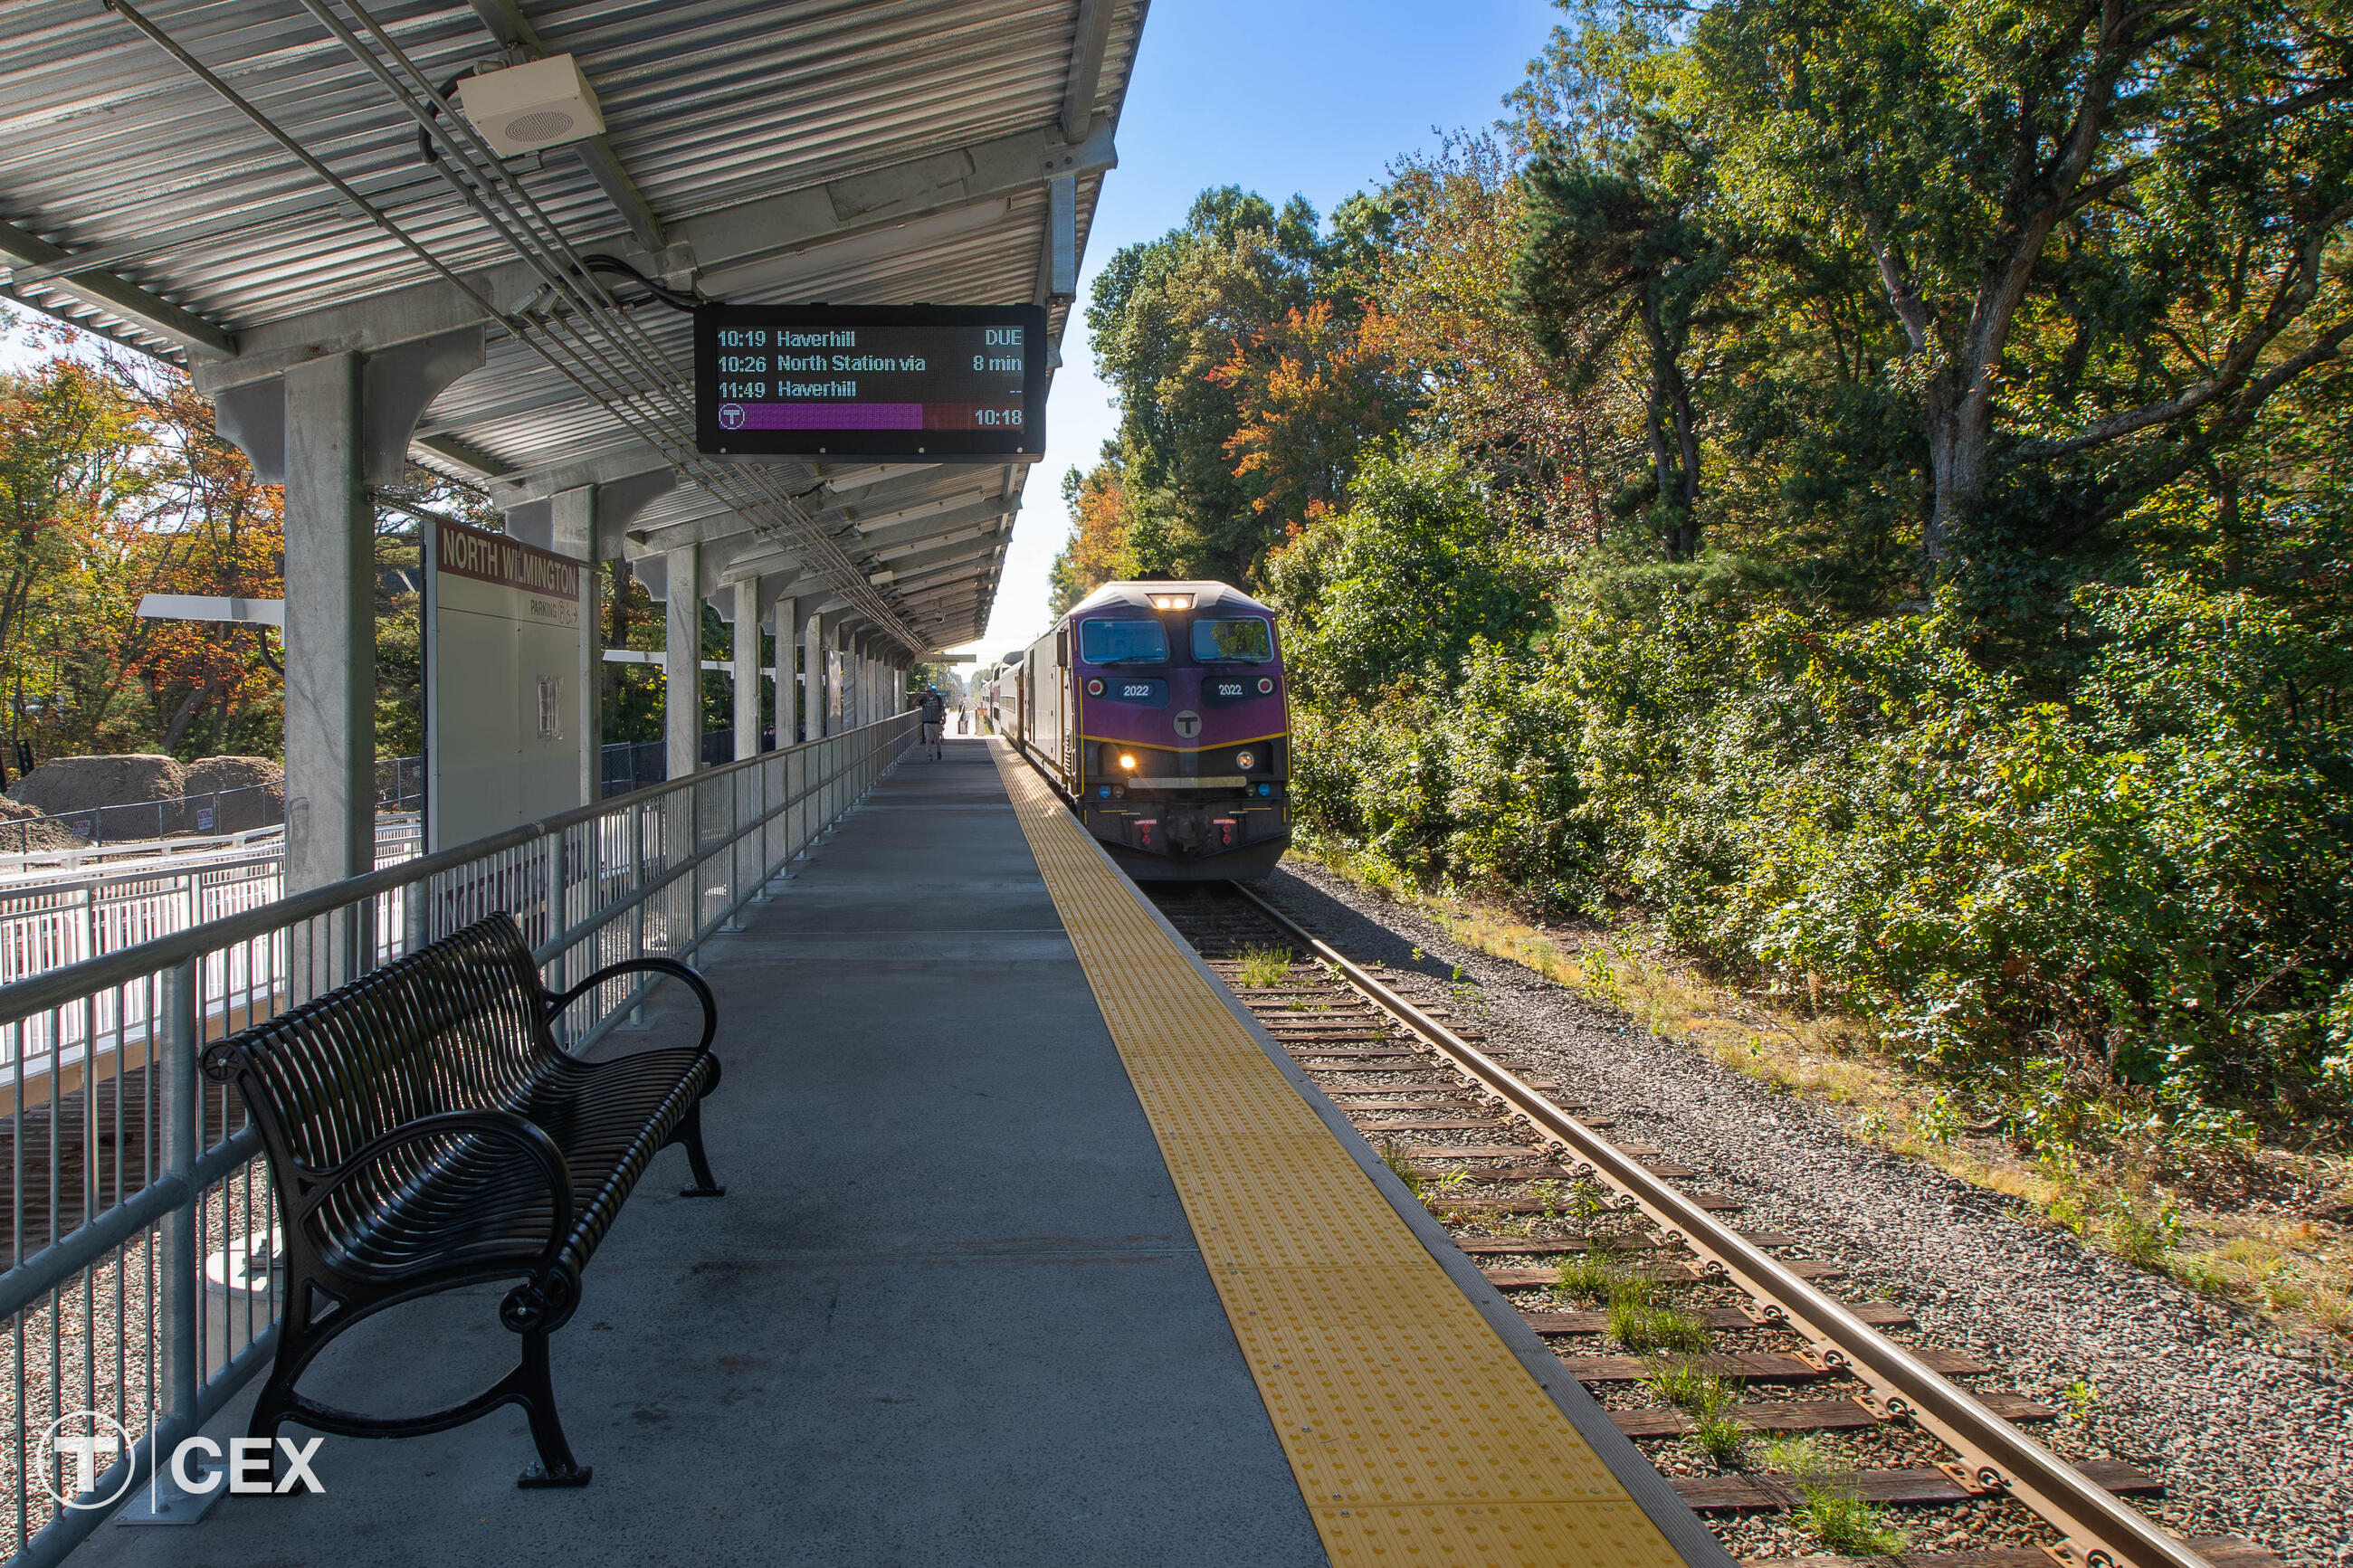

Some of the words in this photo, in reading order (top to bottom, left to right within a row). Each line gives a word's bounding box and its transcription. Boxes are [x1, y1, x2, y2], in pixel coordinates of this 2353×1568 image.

[719, 330, 767, 347] 10:19
[777, 330, 855, 347] Haverhill
[986, 329, 1022, 345] DUE
[719, 356, 767, 373] 10:26
[777, 355, 827, 371] North
[832, 355, 896, 371] Station
[899, 355, 927, 371] via
[973, 355, 985, 371] 8
[989, 355, 1022, 371] min
[719, 382, 766, 398] 11:49
[777, 381, 856, 396] Haverhill
[975, 409, 1022, 425] 10:18
[443, 527, 498, 577] NORTH
[501, 545, 576, 595] WILMINGTON
[530, 599, 557, 619] PARKING
[1123, 684, 1149, 697] 2022
[1218, 684, 1243, 696] 2022
